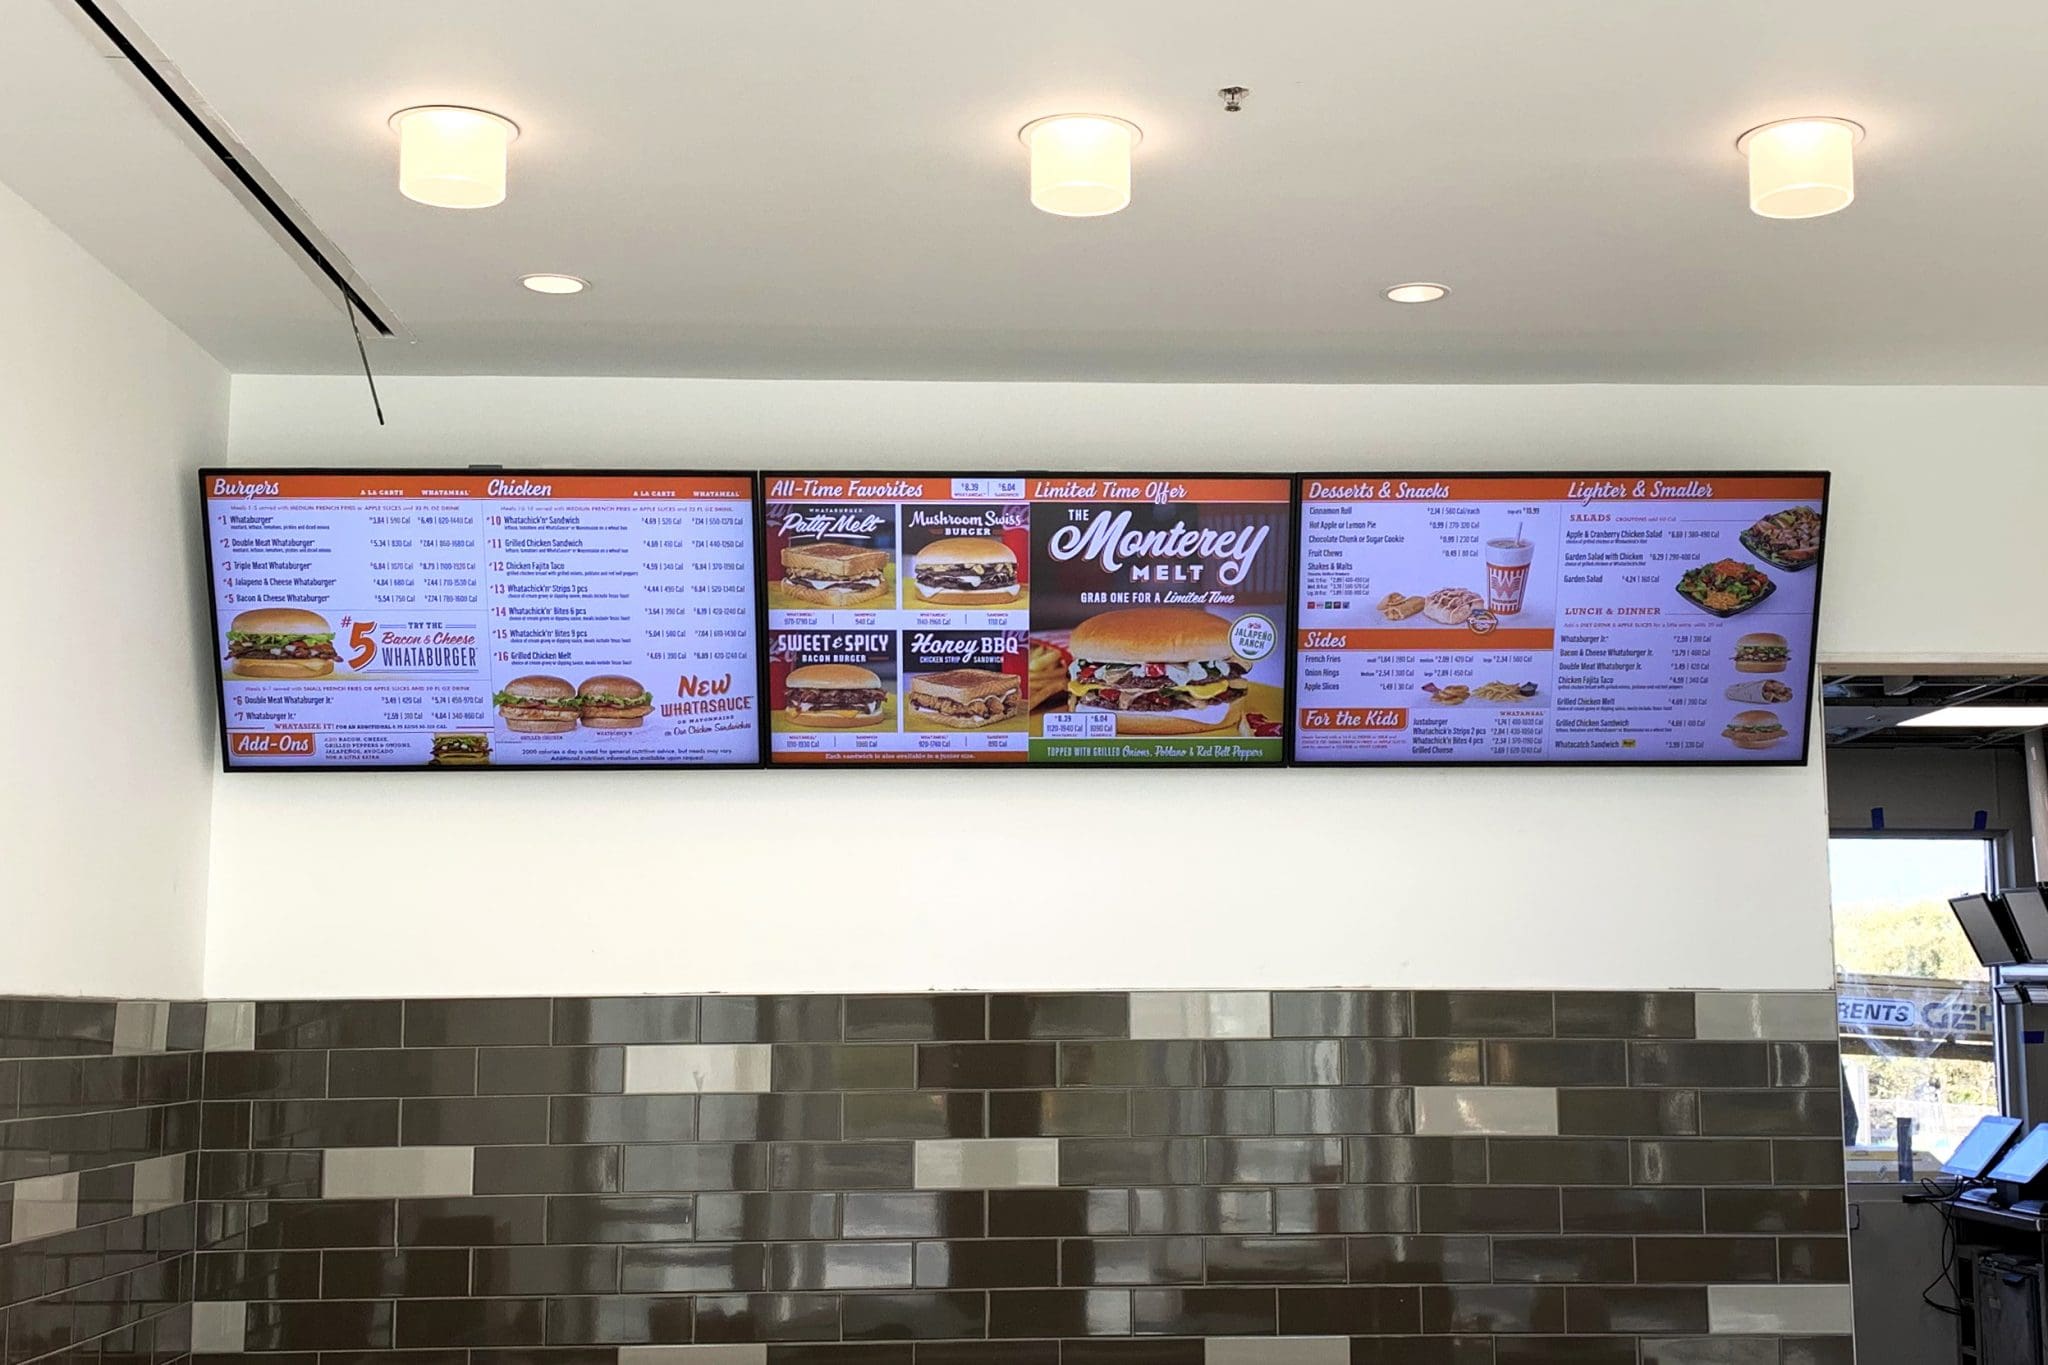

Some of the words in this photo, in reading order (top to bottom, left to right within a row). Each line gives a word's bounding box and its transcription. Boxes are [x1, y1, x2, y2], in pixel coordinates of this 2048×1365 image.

[214, 478, 279, 500] Burgers
[488, 479, 552, 496] Chicken
[771, 480, 843, 497] All-Time
[848, 480, 923, 497] Favorites
[1035, 482, 1096, 498] Limited
[1102, 482, 1140, 498] Time
[1145, 482, 1187, 504] Offer
[1309, 482, 1373, 499] Desserts
[1378, 484, 1391, 498] &
[1396, 482, 1449, 499] Snacks
[1568, 481, 1627, 507] Lighter
[1632, 482, 1645, 496] &
[1650, 481, 1714, 498] Smaller
[1069, 509, 1089, 520] THE
[1309, 507, 1334, 515] Cinnamon
[1337, 507, 1351, 515] Roll
[549, 516, 580, 525] Sandwich
[909, 511, 982, 527] Mushroom
[985, 511, 1021, 526] Swiss
[779, 513, 832, 539] Patty
[830, 514, 885, 532] Melt
[232, 538, 253, 548] Double
[256, 538, 271, 548] Meat
[505, 539, 525, 548] Grilled
[527, 539, 549, 548] Chicken
[550, 539, 583, 548] Sandwich
[1309, 536, 1337, 544] Chocolate
[1339, 536, 1357, 544] Chunk
[1366, 536, 1384, 544] Sugar
[1386, 536, 1404, 544] Cookie
[1050, 510, 1270, 586] Monterey
[1565, 553, 1586, 561] Garden
[1587, 553, 1604, 561] Salad
[1620, 553, 1643, 561] Chicken
[234, 562, 252, 571] Triple
[254, 562, 268, 571] Meat
[506, 562, 528, 571] Chicken
[530, 562, 549, 571] Fajita
[551, 562, 564, 571] Taco
[1131, 565, 1204, 582] MELT
[264, 578, 268, 587] &
[270, 578, 292, 587] Cheese
[237, 594, 255, 603] Bacon
[257, 594, 261, 603] &
[263, 594, 285, 603] Cheese
[1081, 592, 1106, 603] GRAB
[1110, 592, 1128, 603] ONE
[1132, 592, 1151, 603] FOR
[1154, 592, 1160, 603] A
[1164, 591, 1207, 603] Limited
[1209, 591, 1235, 603] Time
[382, 632, 420, 644] Bacon
[423, 634, 430, 643] &
[433, 632, 475, 644] Cheese
[779, 635, 830, 652] SWEET
[846, 635, 888, 652] SPICY
[1239, 638, 1264, 649] RANCH
[1304, 632, 1346, 648] Sides
[911, 633, 979, 663] Honey
[981, 637, 1018, 654] BBQ
[511, 652, 530, 661] Grilled
[532, 652, 554, 661] Chicken
[556, 652, 571, 661] Melt
[802, 654, 831, 663] BACON
[833, 654, 866, 663] BURGER
[1305, 655, 1324, 663] French
[1326, 655, 1340, 663] Fries
[1305, 683, 1320, 691] Apple
[1322, 683, 1339, 691] Slices
[245, 696, 266, 705] Double
[268, 696, 281, 705] Meat
[1306, 711, 1331, 726] For
[1336, 711, 1359, 726] the
[1365, 711, 1398, 726] Kids
[688, 724, 713, 734] Chicken
[238, 735, 308, 751] Add-Ons
[1048, 747, 1070, 756] TOPPED
[1072, 747, 1090, 756] WITH
[1093, 747, 1120, 756] GRILLED
[1155, 746, 1187, 758] Poblano
[1196, 746, 1211, 756] Red
[1214, 746, 1230, 756] Bell
[1232, 746, 1263, 761] Peppers
